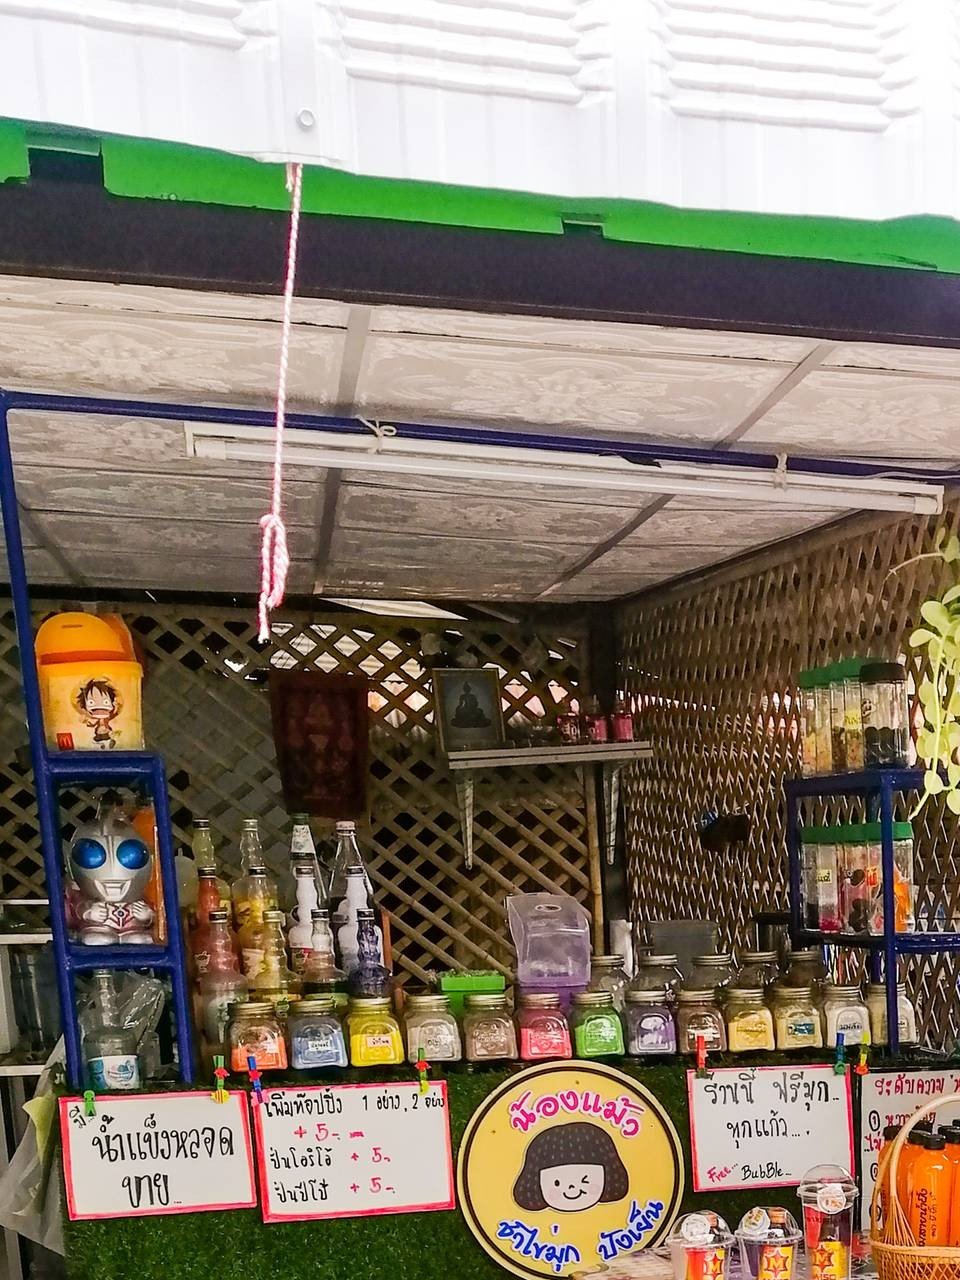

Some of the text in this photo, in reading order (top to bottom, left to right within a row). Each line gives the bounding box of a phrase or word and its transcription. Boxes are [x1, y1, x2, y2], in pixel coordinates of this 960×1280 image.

[362, 1095, 368, 1111] 1
[412, 1093, 418, 1109] 2
[875, 1073, 945, 1096] ระดับความ
[511, 1092, 644, 1136] น้องแม้ว
[92, 1113, 234, 1162] น้ำแข็งหลอด
[598, 1201, 664, 1260] ปังเย็น
